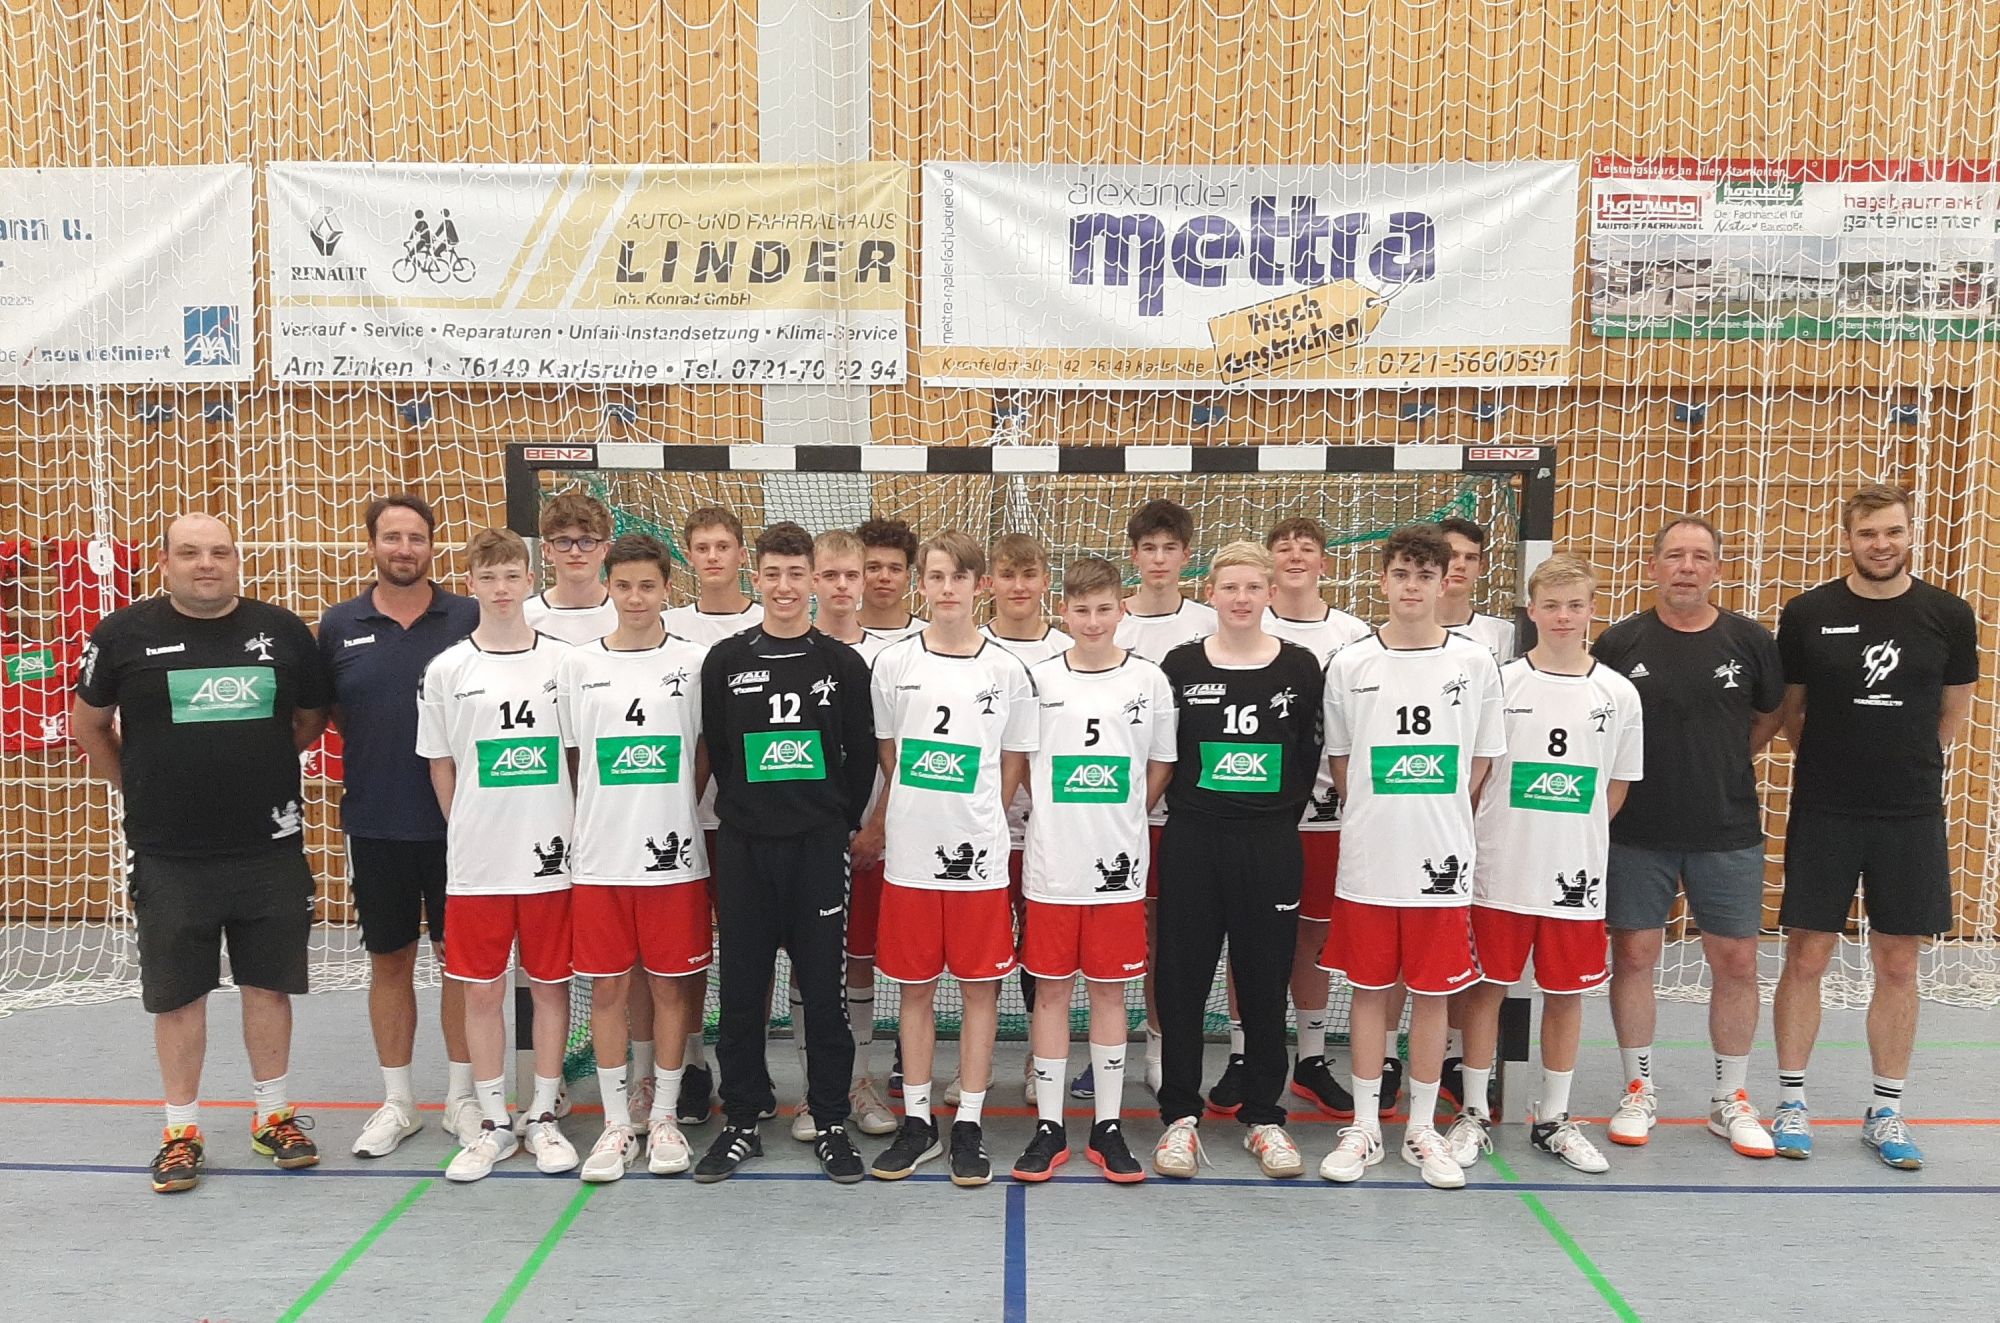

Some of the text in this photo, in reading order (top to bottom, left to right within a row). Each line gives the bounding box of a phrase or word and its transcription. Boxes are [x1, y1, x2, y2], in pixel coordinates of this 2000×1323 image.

[1679, 167, 1693, 175] an
[1696, 165, 1723, 176] allen
[1067, 173, 1238, 207] alexander
[62, 219, 92, 241] u.
[626, 213, 897, 231] AUTO- UND FAHRRADHAUS
[615, 240, 897, 283] LINDER
[1069, 195, 1436, 317] mettra
[290, 266, 367, 281] RENAULT
[645, 292, 701, 305] Konrad
[704, 292, 751, 305] GmbH
[280, 321, 347, 337] Verkauf
[364, 322, 424, 338] Service
[442, 323, 551, 342] Reparaturen
[283, 356, 325, 377] Am
[332, 356, 413, 377] Zinken
[538, 359, 658, 379] Karlsruhe
[684, 359, 722, 379] Tel.
[870, 360, 897, 380] 94
[942, 357, 1049, 372] Kirchfeldstaß
[1379, 351, 1559, 374] 0721-5600691
[526, 449, 588, 460] BENZ
[1470, 448, 1535, 460] BENZ
[189, 675, 260, 704] AOK
[499, 700, 536, 730] 14
[625, 697, 646, 727] 4
[768, 692, 801, 724] 12
[932, 705, 951, 735] 2
[1222, 704, 1259, 735] 16
[1396, 705, 1432, 736] 18
[1084, 718, 1100, 747] 5
[1547, 728, 1568, 758] 8
[492, 745, 548, 770] AOK
[612, 744, 667, 768] AOK
[761, 739, 814, 764] AOK
[911, 750, 966, 776] AOK
[1213, 751, 1269, 775] AOK
[1064, 763, 1119, 787] AOK
[1386, 754, 1445, 778] AOK
[1526, 772, 1583, 797] AOK
